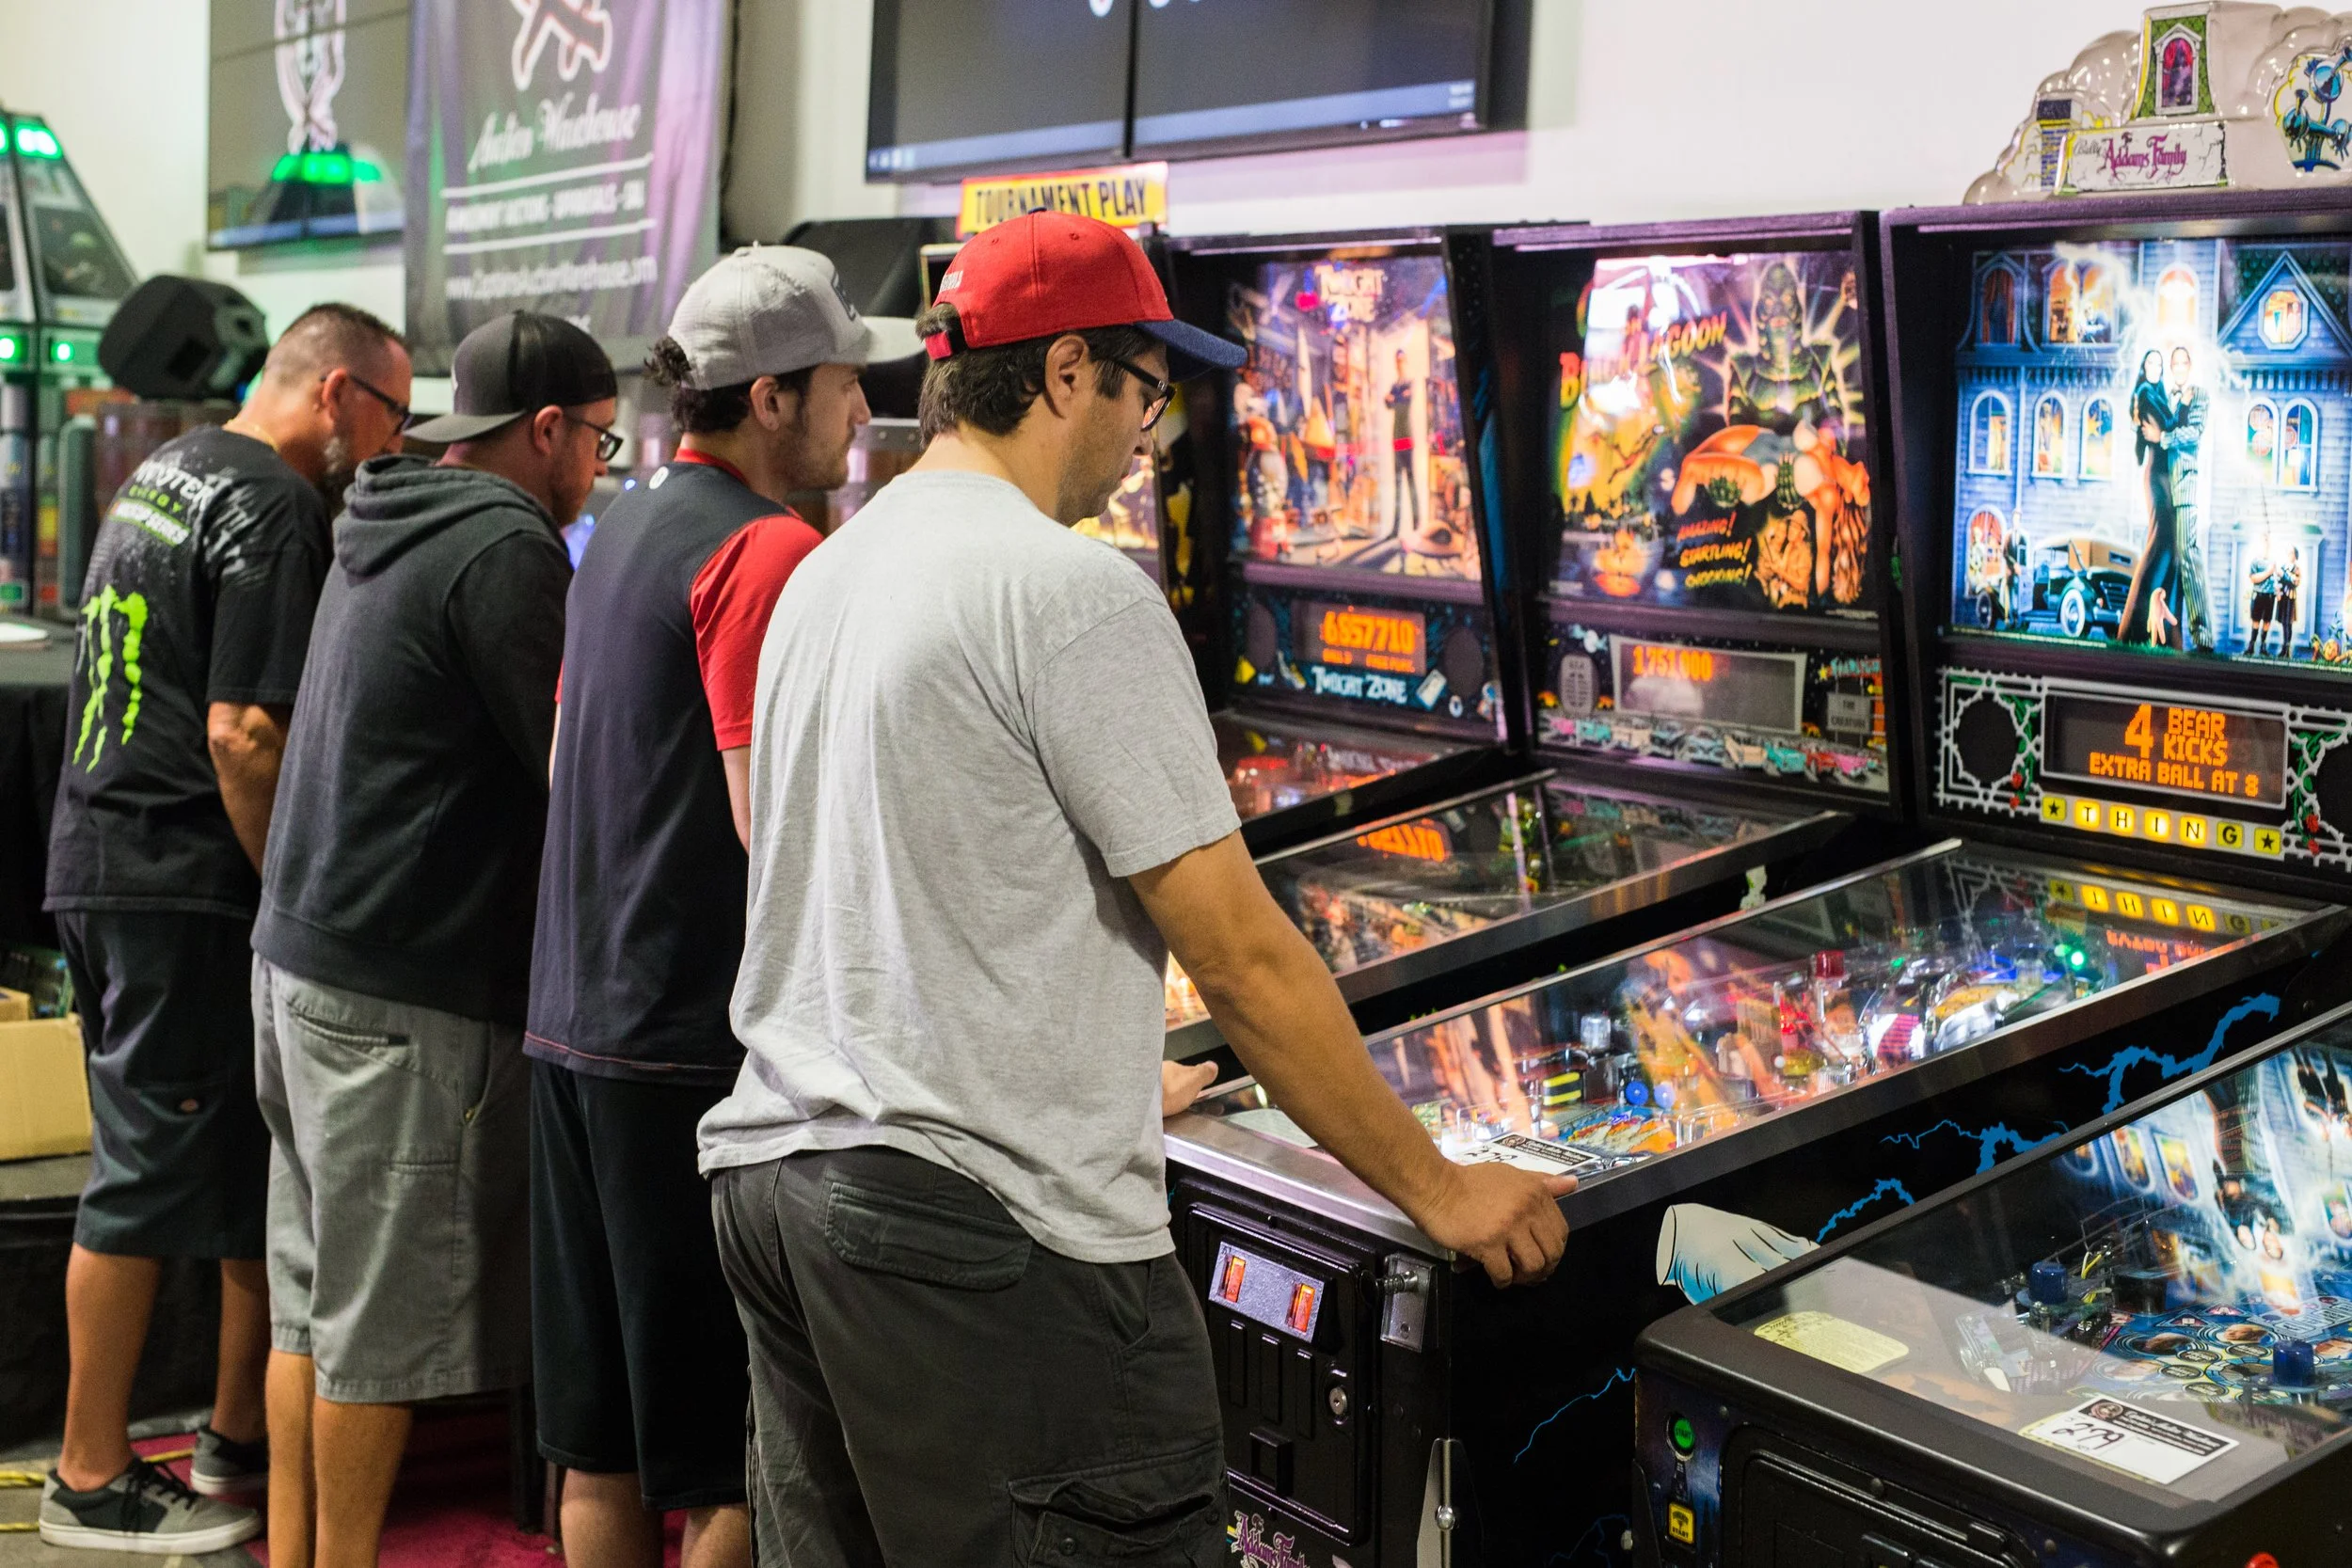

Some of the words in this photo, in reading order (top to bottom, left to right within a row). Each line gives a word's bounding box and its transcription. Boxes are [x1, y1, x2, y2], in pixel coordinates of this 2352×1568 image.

[2097, 137, 2150, 172] Addams
[2145, 134, 2187, 177] Family
[976, 183, 1091, 224] TOURNAMENT
[1099, 179, 1148, 217] PLAY
[1679, 537, 1752, 567] STARTLING!
[2123, 703, 2154, 759] 4
[2168, 706, 2226, 739] BEAR
[2164, 733, 2228, 767] KICKS
[2089, 752, 2152, 783] EXTRA
[2157, 761, 2205, 791] BALL
[2211, 769, 2238, 794] AT
[2244, 773, 2260, 798] 8
[2083, 806, 2238, 845] THING
[2052, 1421, 2126, 1450] 279
[1231, 1510, 1279, 1567] Addams
